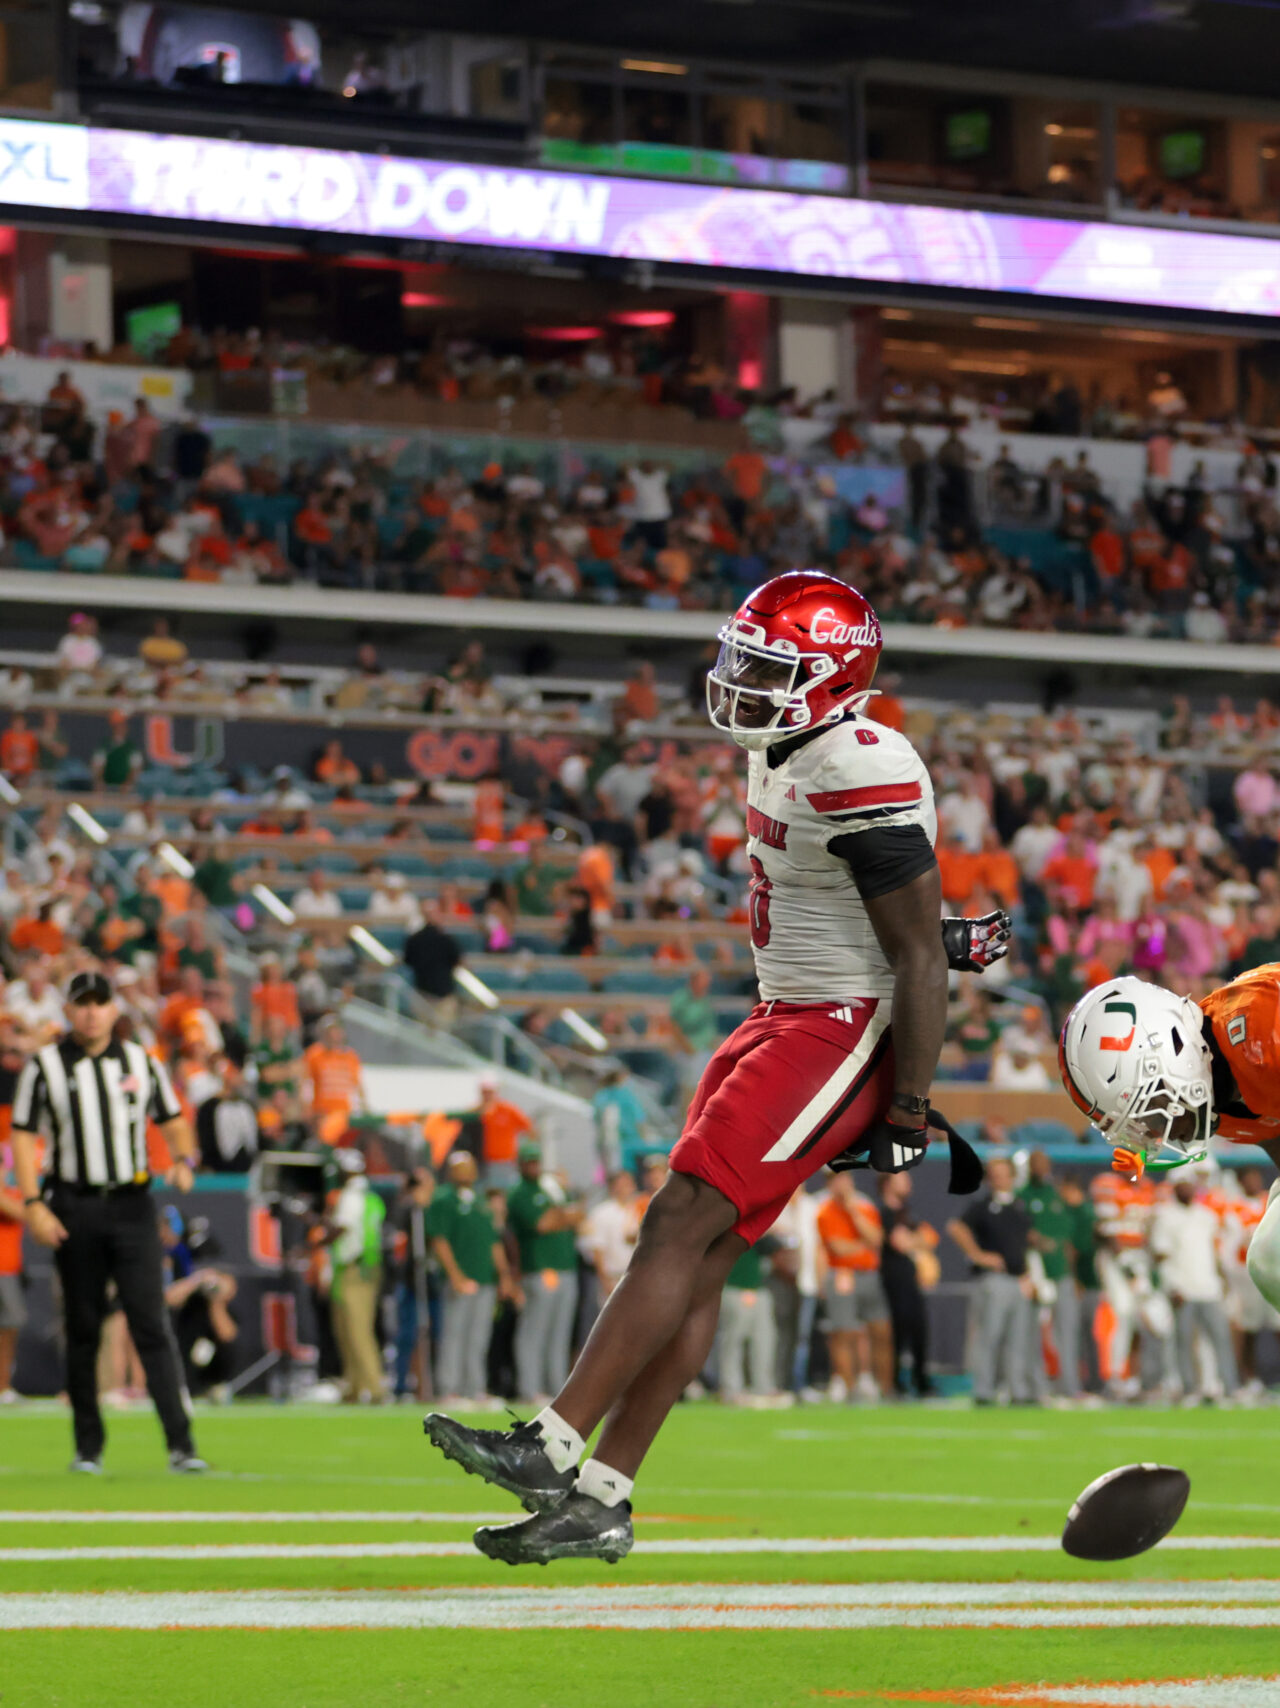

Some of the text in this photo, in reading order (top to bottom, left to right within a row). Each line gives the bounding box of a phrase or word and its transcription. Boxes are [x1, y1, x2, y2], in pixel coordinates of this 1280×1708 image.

[121, 135, 611, 246] THIRD DOWN
[810, 607, 878, 647] Cards
[1099, 1002, 1137, 1052] U
